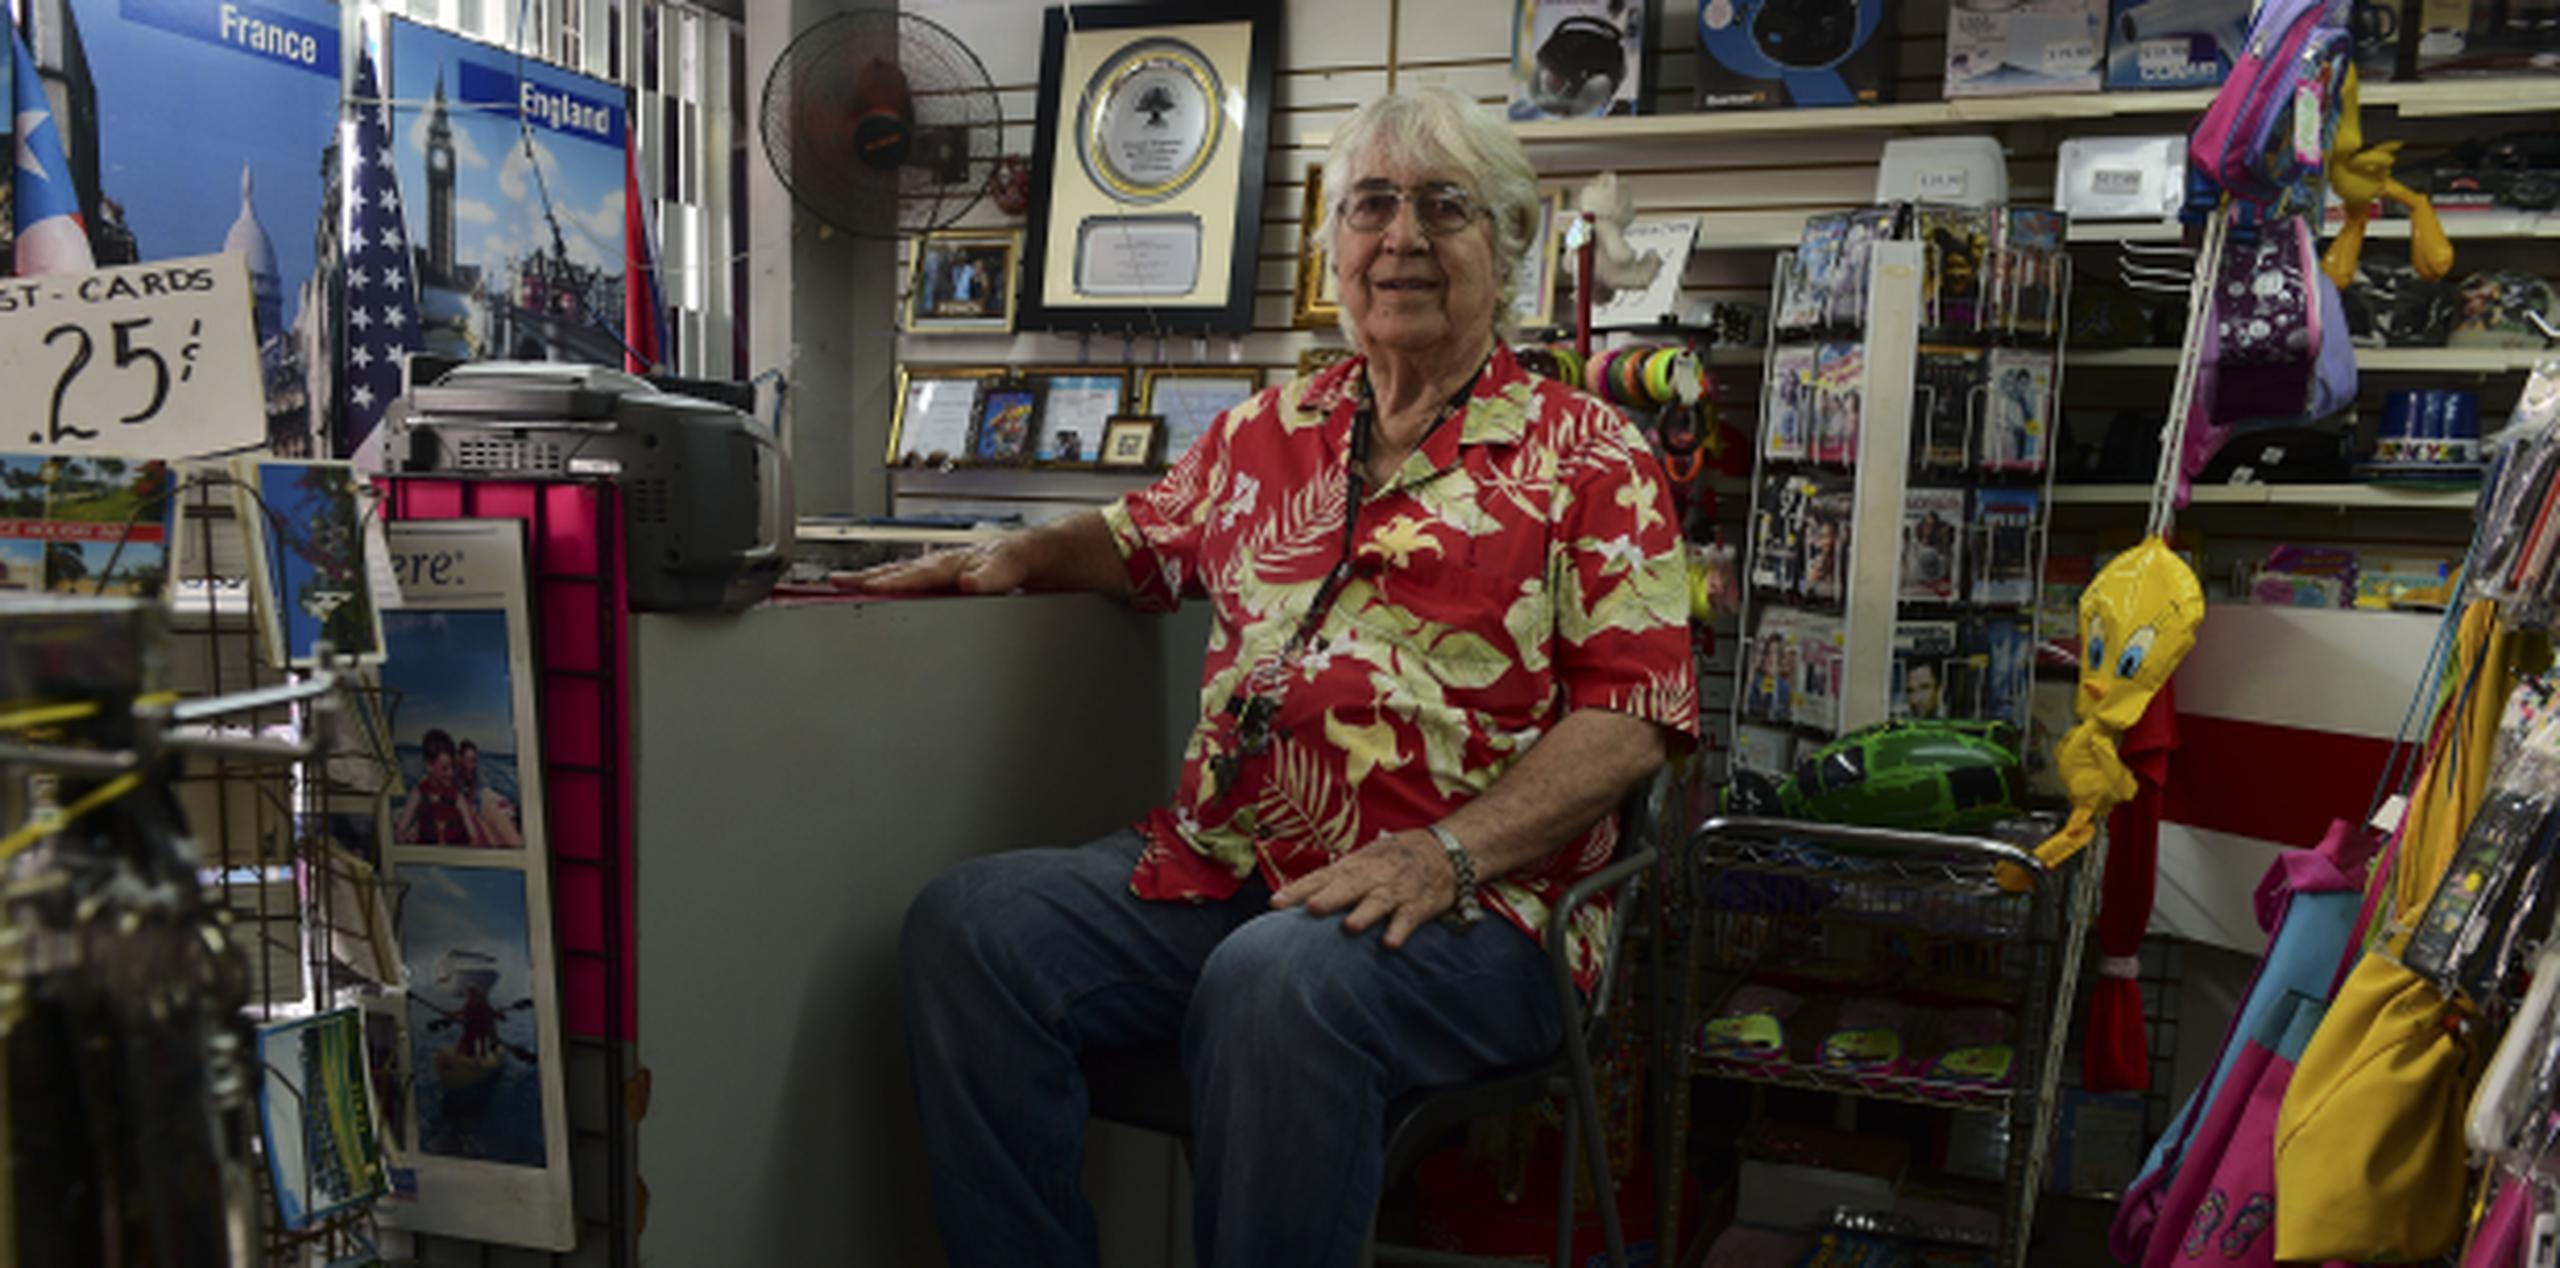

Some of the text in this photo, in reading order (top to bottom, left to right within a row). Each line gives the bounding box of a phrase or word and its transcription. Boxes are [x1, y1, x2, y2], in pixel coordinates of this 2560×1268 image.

[219, 3, 317, 64] France
[520, 80, 610, 135] England
[78, 268, 214, 302] CARDS
